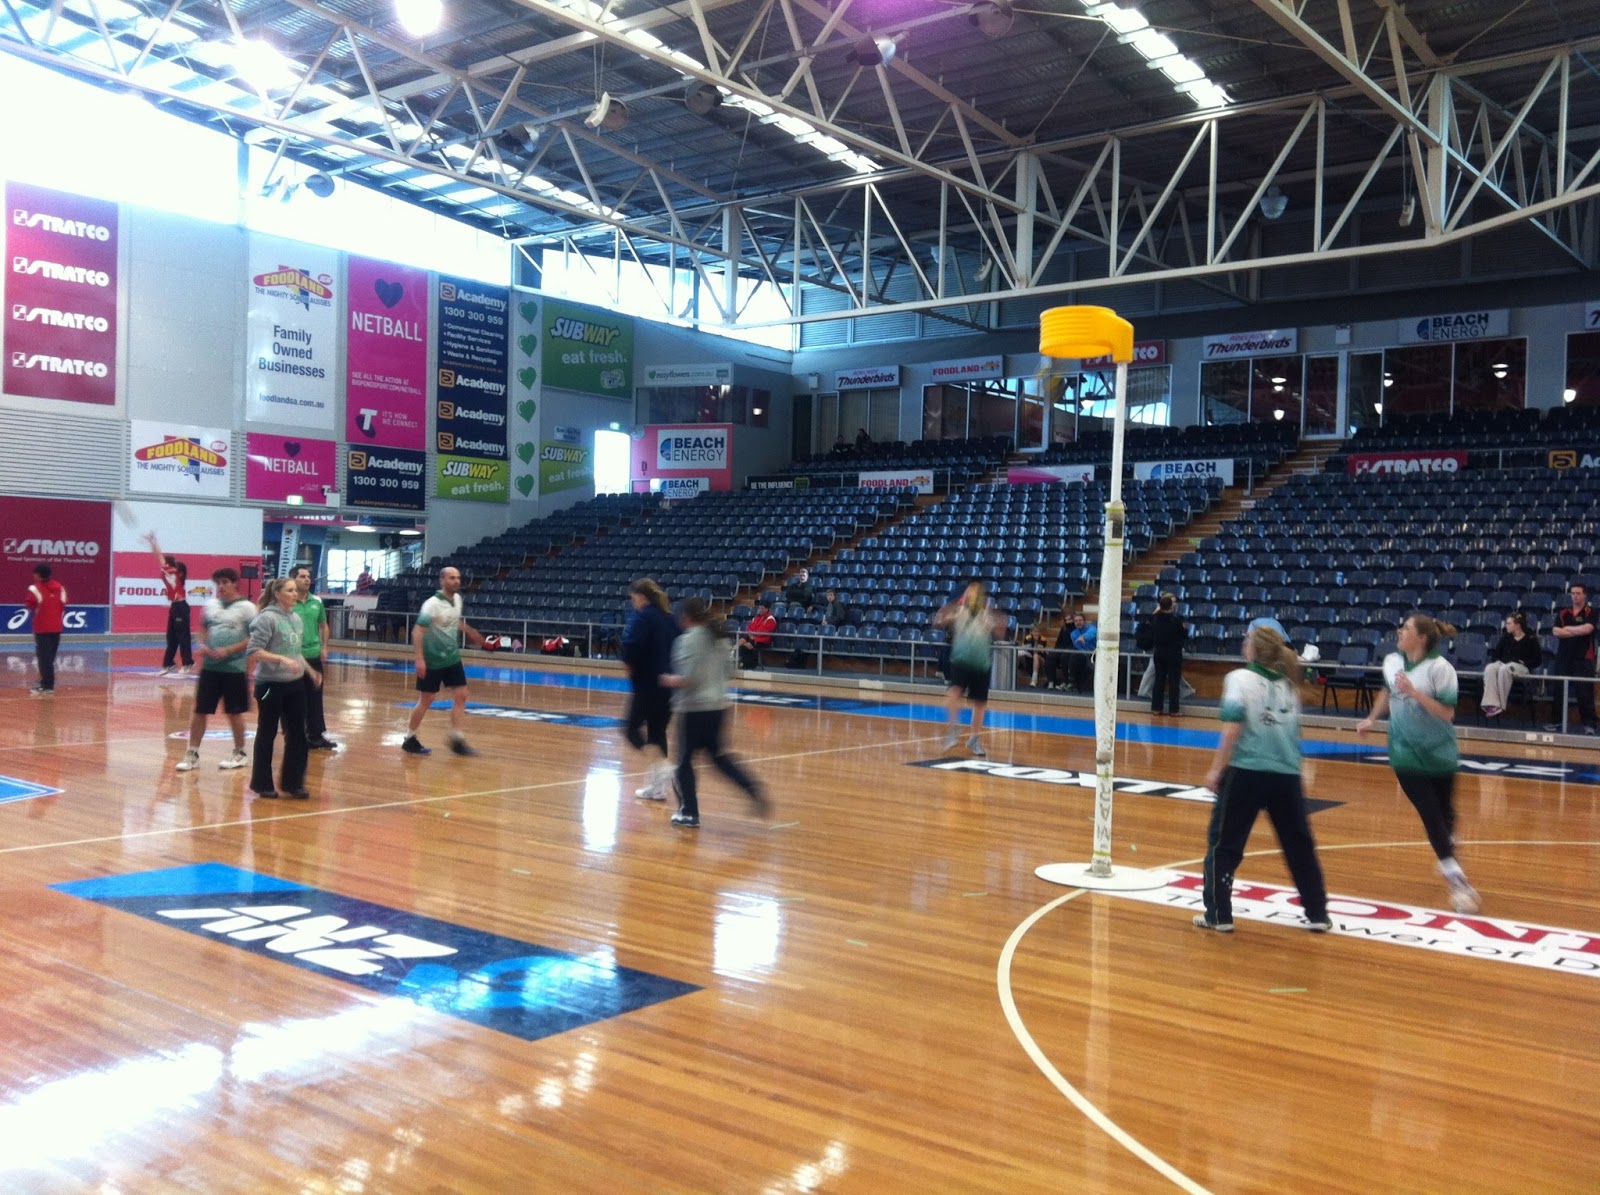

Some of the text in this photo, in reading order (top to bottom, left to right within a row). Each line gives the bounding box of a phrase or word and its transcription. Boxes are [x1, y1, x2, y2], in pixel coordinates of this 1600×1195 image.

[26, 213, 110, 242] STRATCO
[26, 260, 110, 287] STRATCO
[263, 271, 325, 296] FOODLAND
[457, 289, 507, 312] Academy
[26, 307, 108, 333] STRATCO
[444, 306, 504, 326] 1300 300 959
[1432, 313, 1489, 328] BEACH
[274, 325, 312, 345] Family
[352, 311, 423, 342] NETBALL
[550, 317, 620, 347] SUBWAY
[1432, 324, 1488, 339] ENERGY
[272, 342, 312, 360] Owned
[1208, 337, 1292, 356] Thunderbirds
[562, 349, 627, 364] eat fresh.
[25, 354, 108, 378] STRATCO
[258, 357, 325, 378] Businesses
[933, 364, 980, 376] FOODLAND
[456, 374, 506, 396] Academy
[838, 373, 895, 387] Thunderbirds
[258, 392, 325, 409] foodlandsa.com.au
[455, 406, 505, 426] Academy
[455, 437, 505, 456] Academy
[674, 437, 725, 449] BEACH
[146, 440, 218, 465] FOODLAND
[541, 446, 589, 464] SUBWAY
[673, 449, 724, 461] ENERGY
[137, 462, 148, 470] THE
[150, 463, 176, 473] MIGHTY
[200, 467, 225, 476] AUSSIES
[264, 458, 319, 476] NETBALL
[367, 456, 423, 475] Academy
[442, 461, 499, 479] SUBWAY
[1165, 462, 1217, 474] BEACH
[1370, 457, 1458, 474] STRATCO
[353, 476, 420, 490] 1300 300 959
[451, 481, 505, 495] eat fresh.
[668, 480, 699, 488] BEACH
[861, 479, 909, 487] FOODLAND
[668, 488, 699, 498] ENERGY
[16, 539, 99, 556] STRATCO
[119, 586, 168, 597] FOODLA
[156, 905, 459, 976] ANZ
